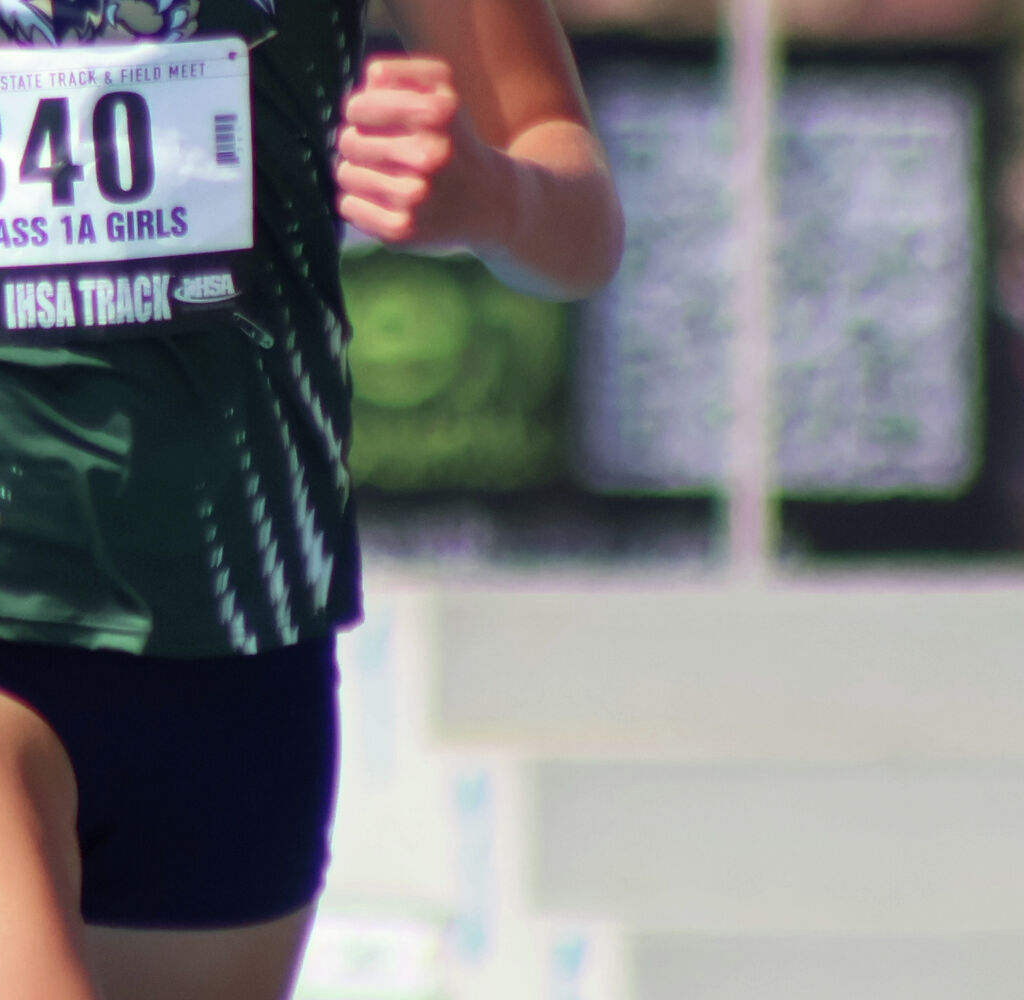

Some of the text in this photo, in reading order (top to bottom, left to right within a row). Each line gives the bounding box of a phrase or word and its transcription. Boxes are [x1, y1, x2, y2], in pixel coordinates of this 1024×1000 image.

[0, 73, 42, 91] STATE
[49, 70, 97, 88] TRACK
[104, 71, 113, 85] &
[121, 66, 161, 83] FIELD
[168, 63, 206, 80] MEET
[60, 214, 97, 245] 1A
[106, 206, 189, 243] GIRLS
[4, 273, 172, 330] IHSA TRACK
